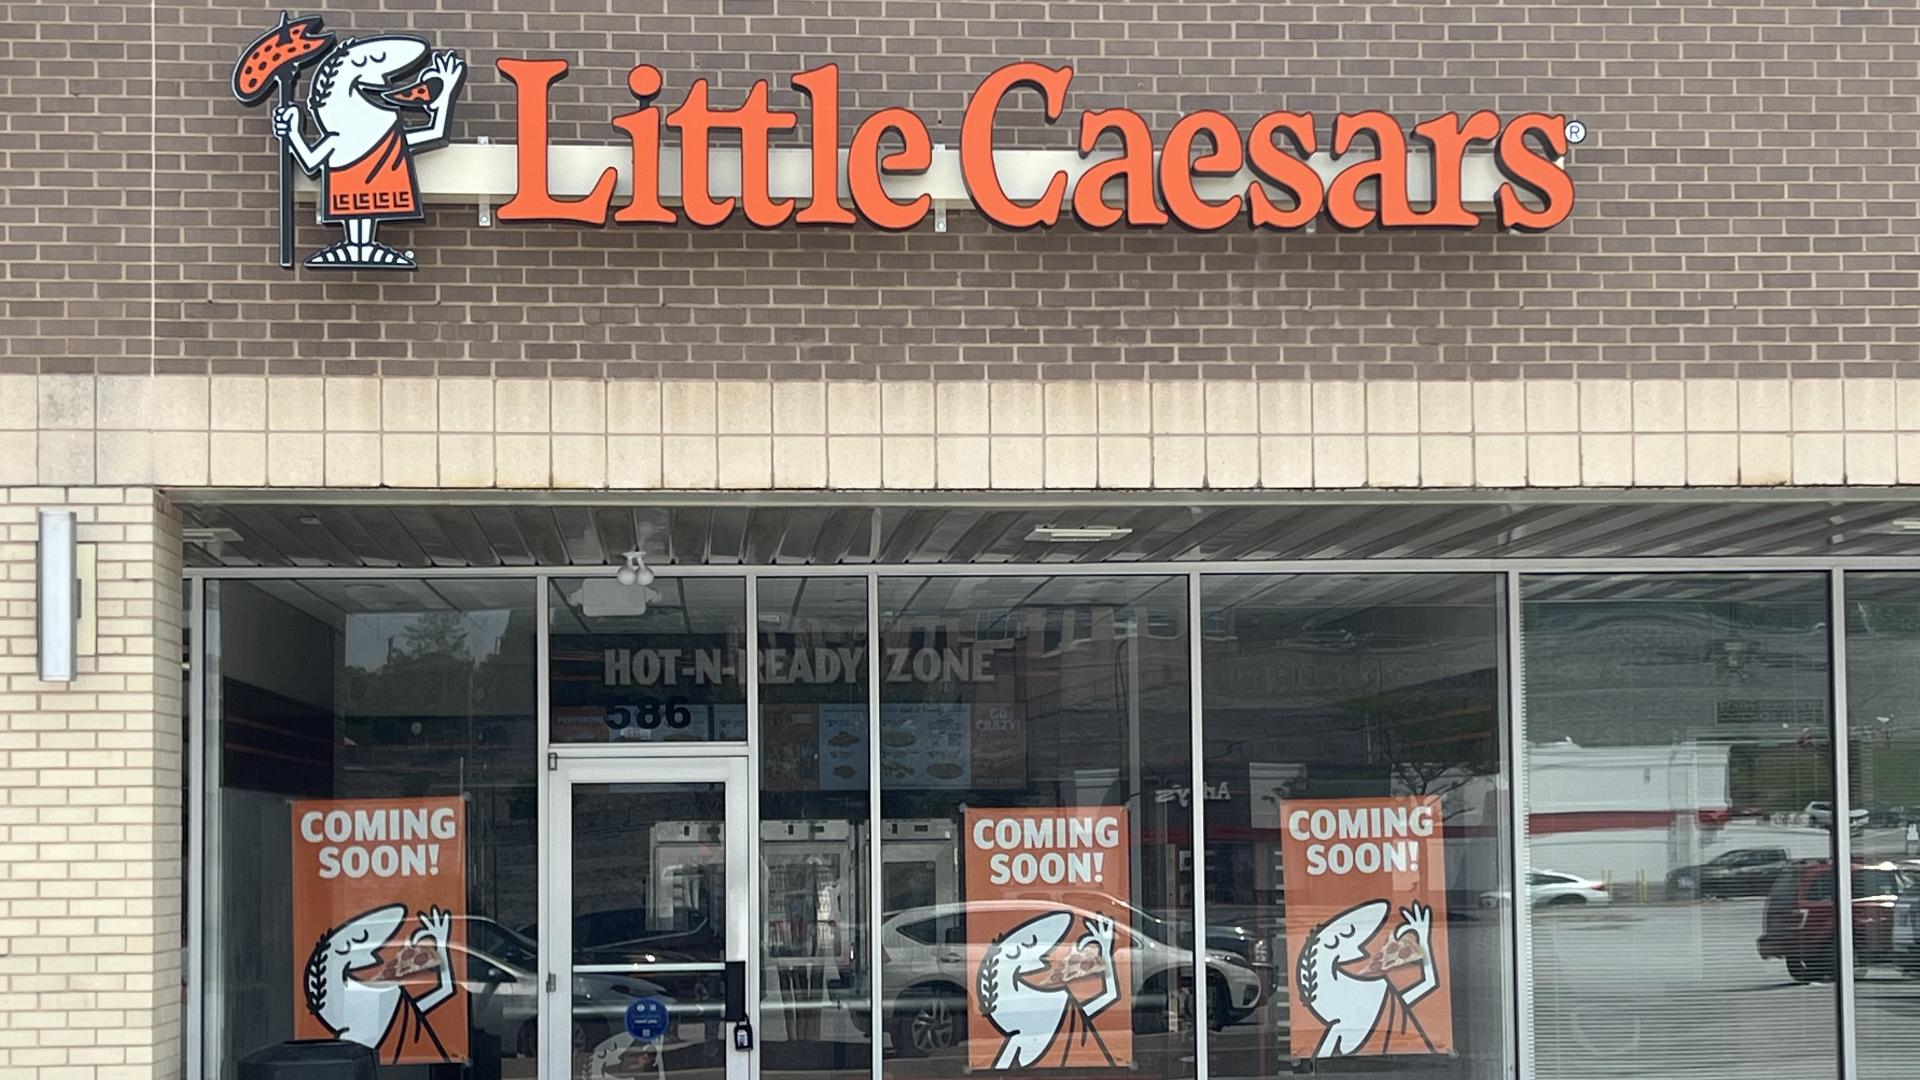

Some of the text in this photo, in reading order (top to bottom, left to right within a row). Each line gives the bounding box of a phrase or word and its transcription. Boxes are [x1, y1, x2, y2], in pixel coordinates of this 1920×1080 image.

[496, 58, 933, 229] Little
[960, 61, 1575, 230] Caesars
[604, 647, 995, 685] HOT-N-READY ZONE
[605, 696, 691, 730] 586
[301, 807, 456, 843] COMING
[973, 816, 1119, 850] COMING
[1288, 806, 1434, 840] COMING
[319, 844, 439, 879] SOON!
[990, 852, 1104, 885] SOON!
[1306, 841, 1419, 875] SOON!
